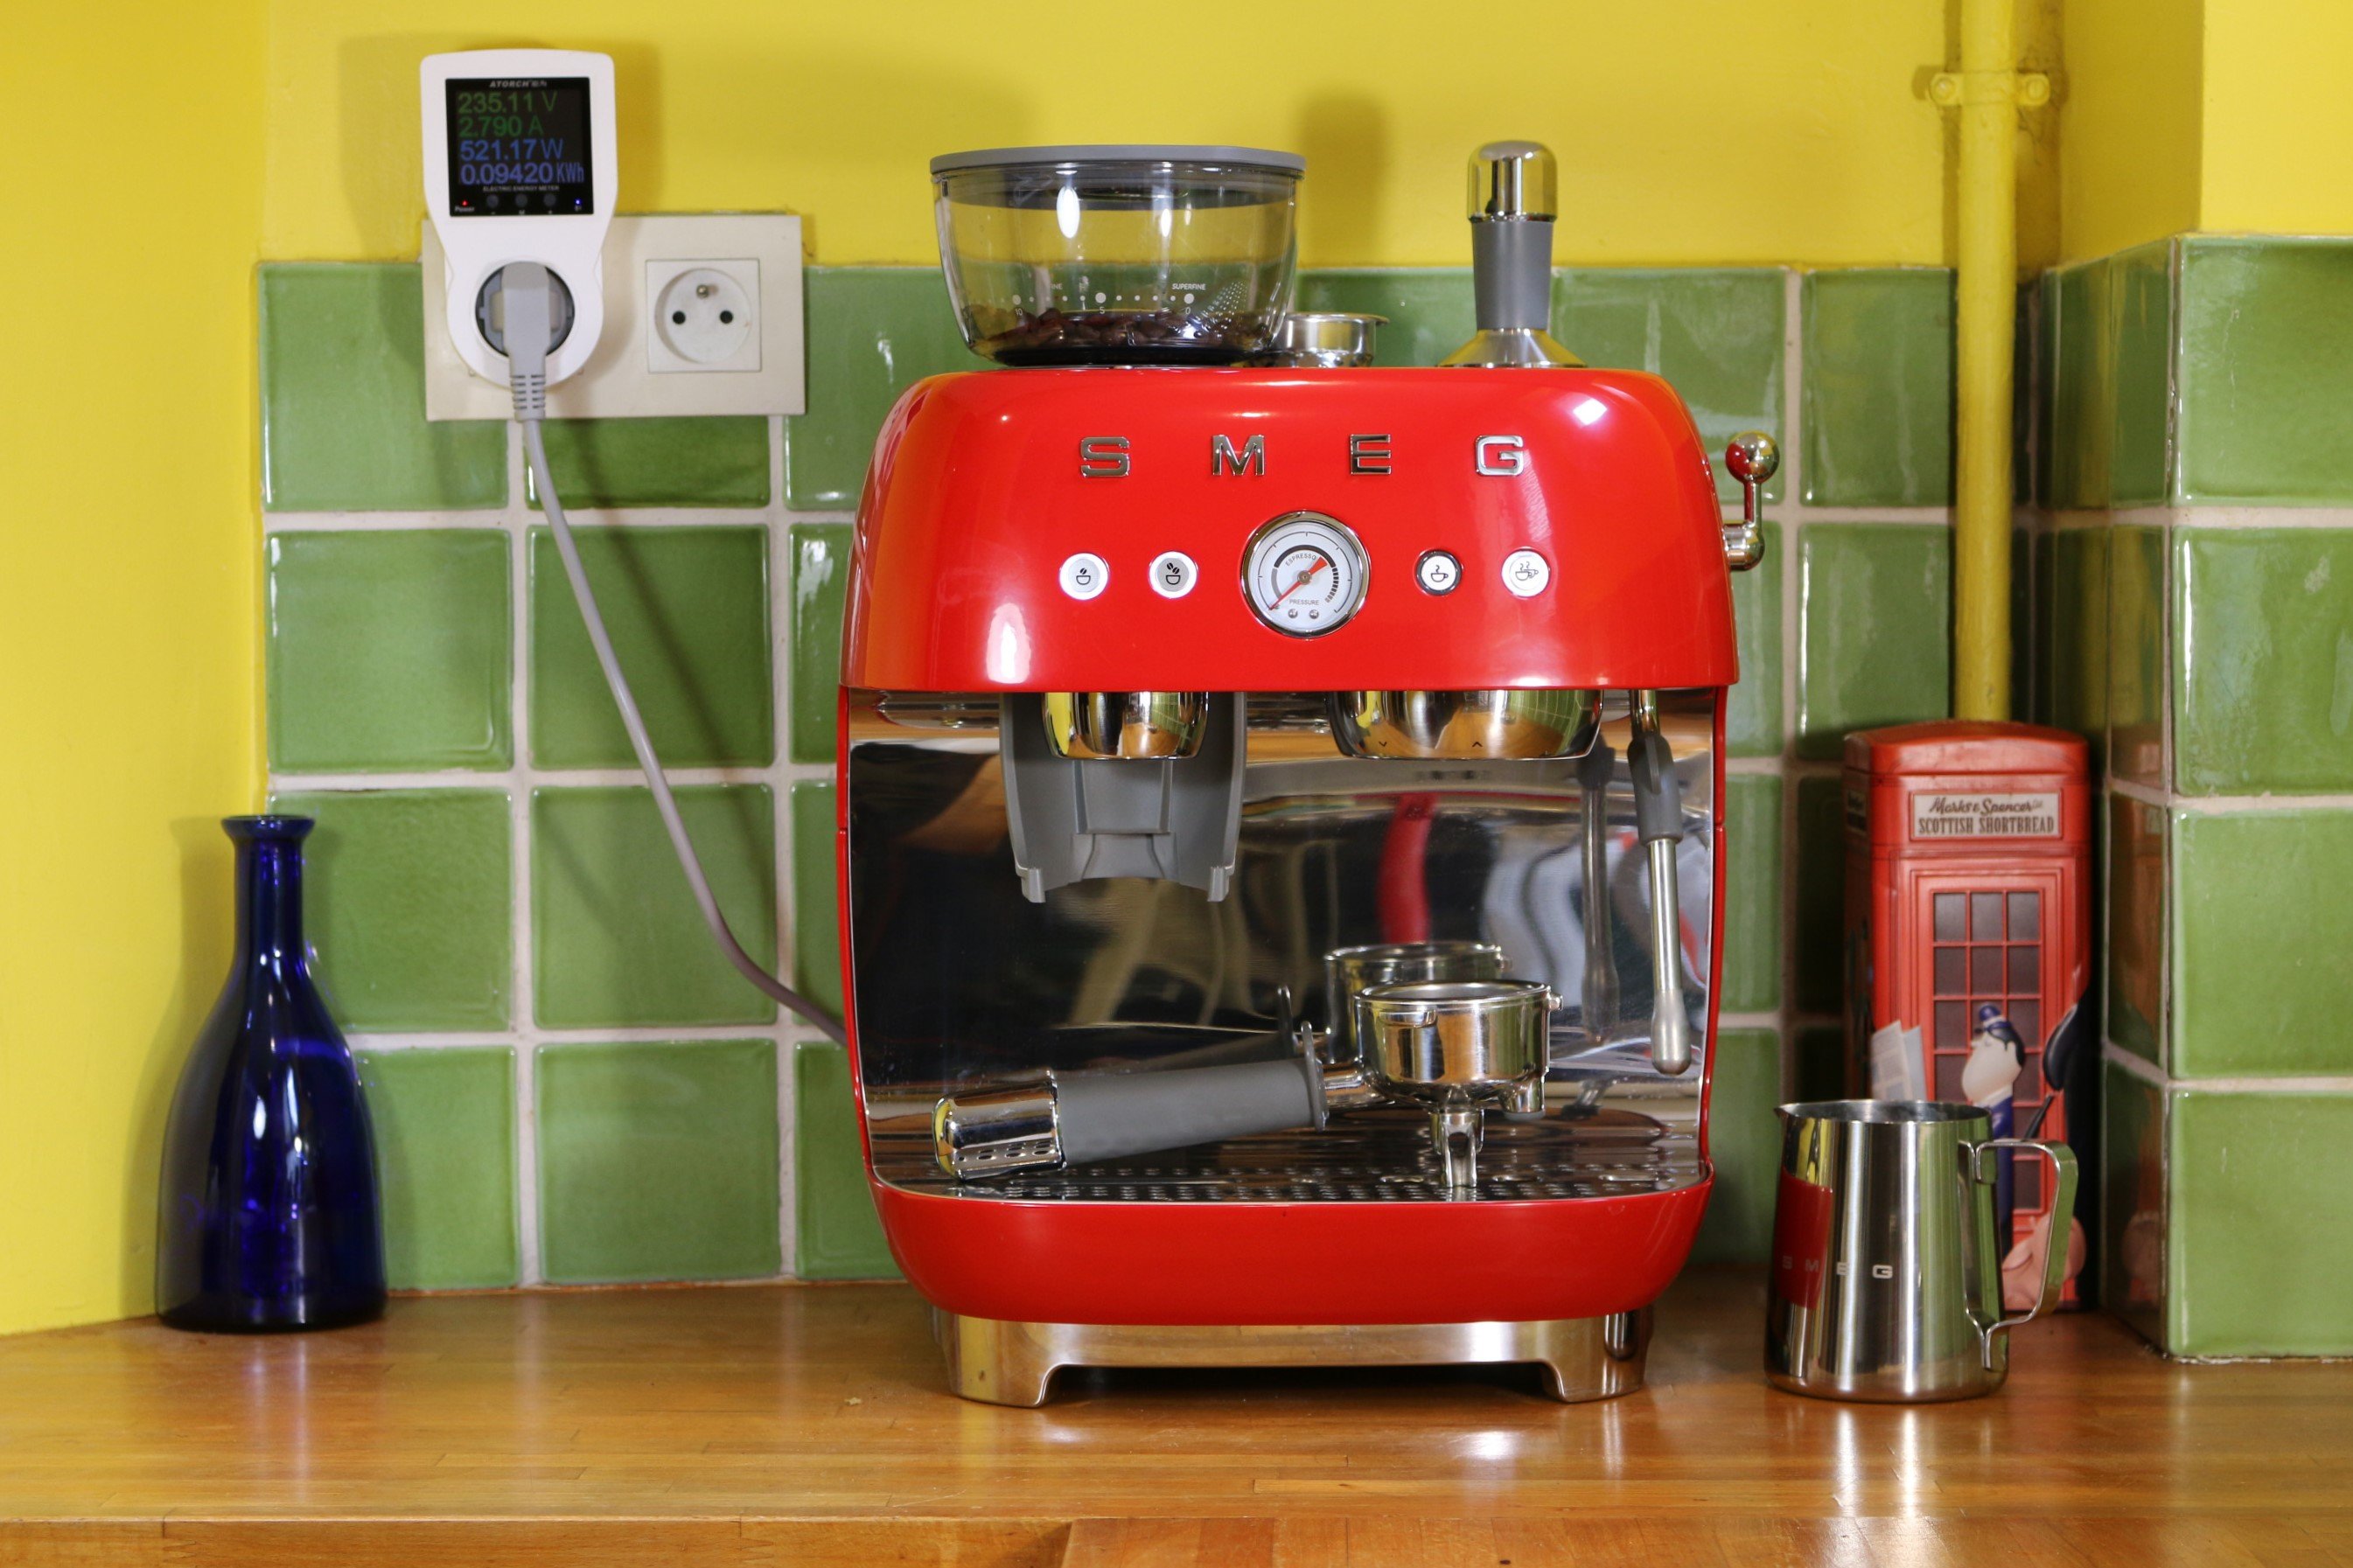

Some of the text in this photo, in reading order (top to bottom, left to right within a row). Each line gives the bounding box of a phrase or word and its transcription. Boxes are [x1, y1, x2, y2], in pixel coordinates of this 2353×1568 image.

[458, 90, 558, 114] 235.11 V
[458, 115, 544, 137] 2.790 A
[460, 138, 564, 162] 521.17 W
[461, 163, 553, 185] 0.09420
[1016, 308, 1023, 317] 10
[1100, 306, 1106, 315] 5
[1079, 434, 1525, 478] SMEG
[1285, 553, 1316, 567] ESPRESSO
[1929, 797, 1972, 814] Marks
[1979, 798, 2033, 816] Spencer
[1918, 816, 2054, 834] SCOTTISH SHORTBREAD
